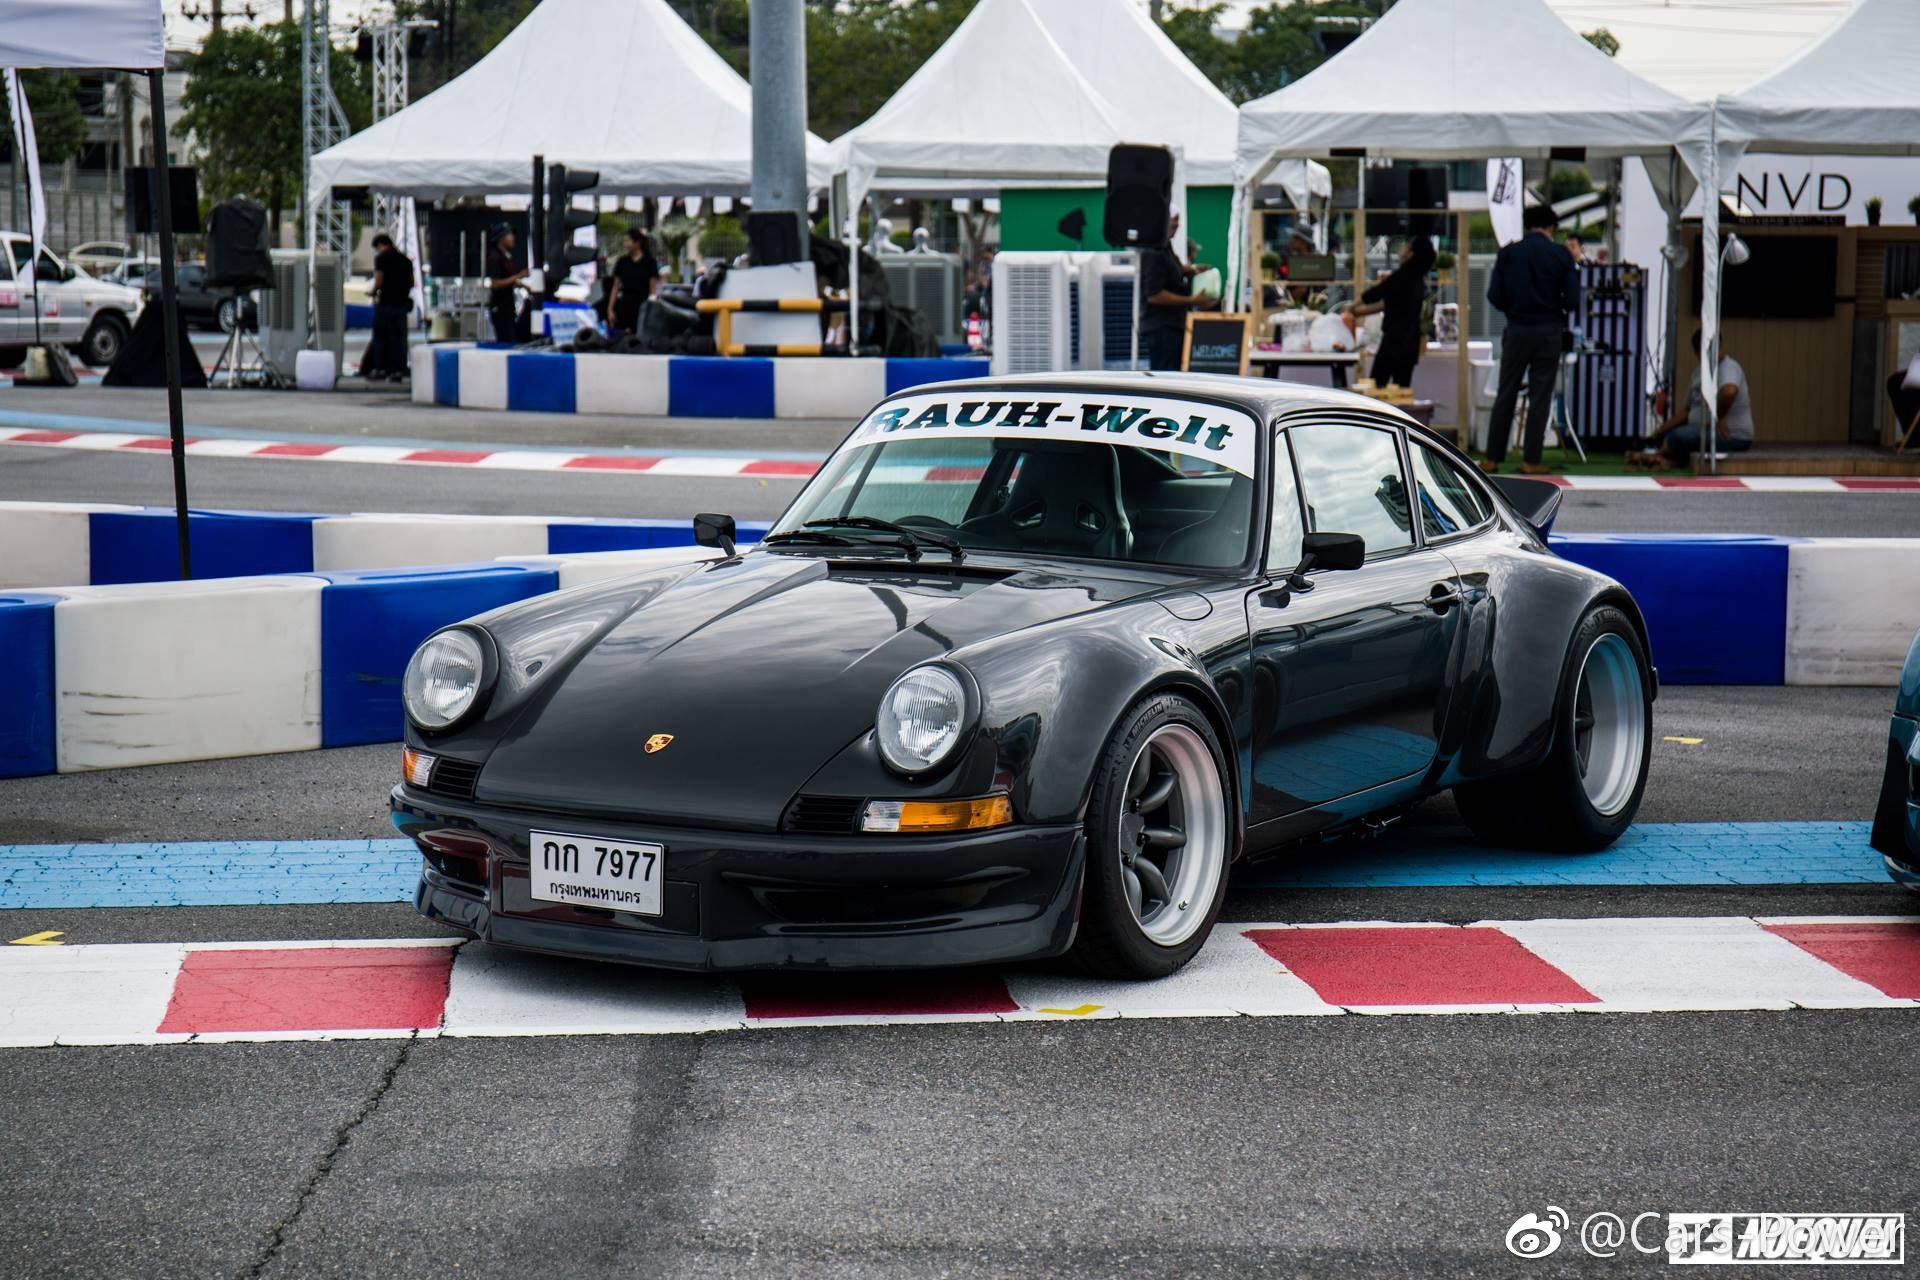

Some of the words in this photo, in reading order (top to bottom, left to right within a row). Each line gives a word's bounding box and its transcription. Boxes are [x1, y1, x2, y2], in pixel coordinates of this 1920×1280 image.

[1737, 171, 1852, 211] NVD
[864, 401, 1234, 451] RAUH-Welt
[543, 841, 579, 873] กก
[594, 846, 656, 882] 7977
[550, 882, 641, 904] กรุงเทพมหานคร
